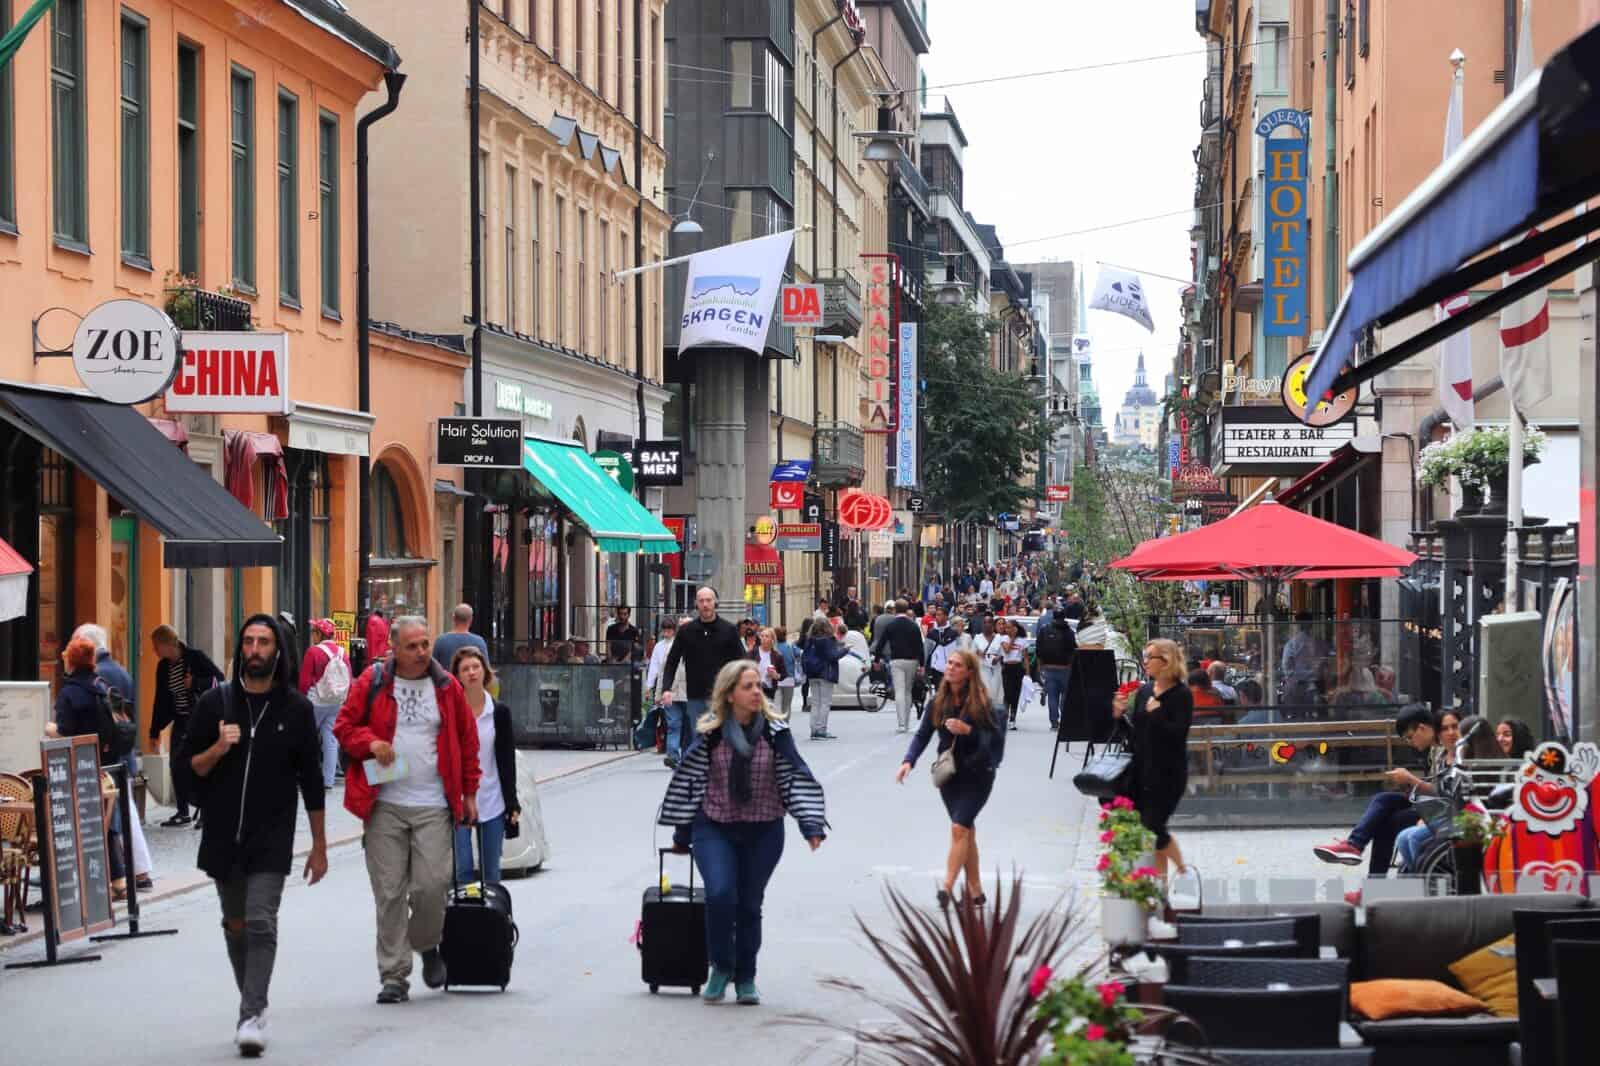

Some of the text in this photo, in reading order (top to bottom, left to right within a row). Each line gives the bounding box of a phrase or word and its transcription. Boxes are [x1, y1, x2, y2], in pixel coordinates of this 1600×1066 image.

[1269, 151, 1302, 325] HOTEL
[783, 287, 821, 315] DA
[682, 307, 763, 329] SKAGEN
[86, 328, 163, 361] ZOE
[869, 265, 889, 423] SKANDIA
[172, 350, 279, 396] CHINA
[440, 423, 519, 438] Hair Solution
[1230, 429, 1324, 440] TEATER & BAR
[640, 451, 680, 463] SALT
[1238, 447, 1315, 457] RESTAURANT
[642, 463, 678, 475] MEN
